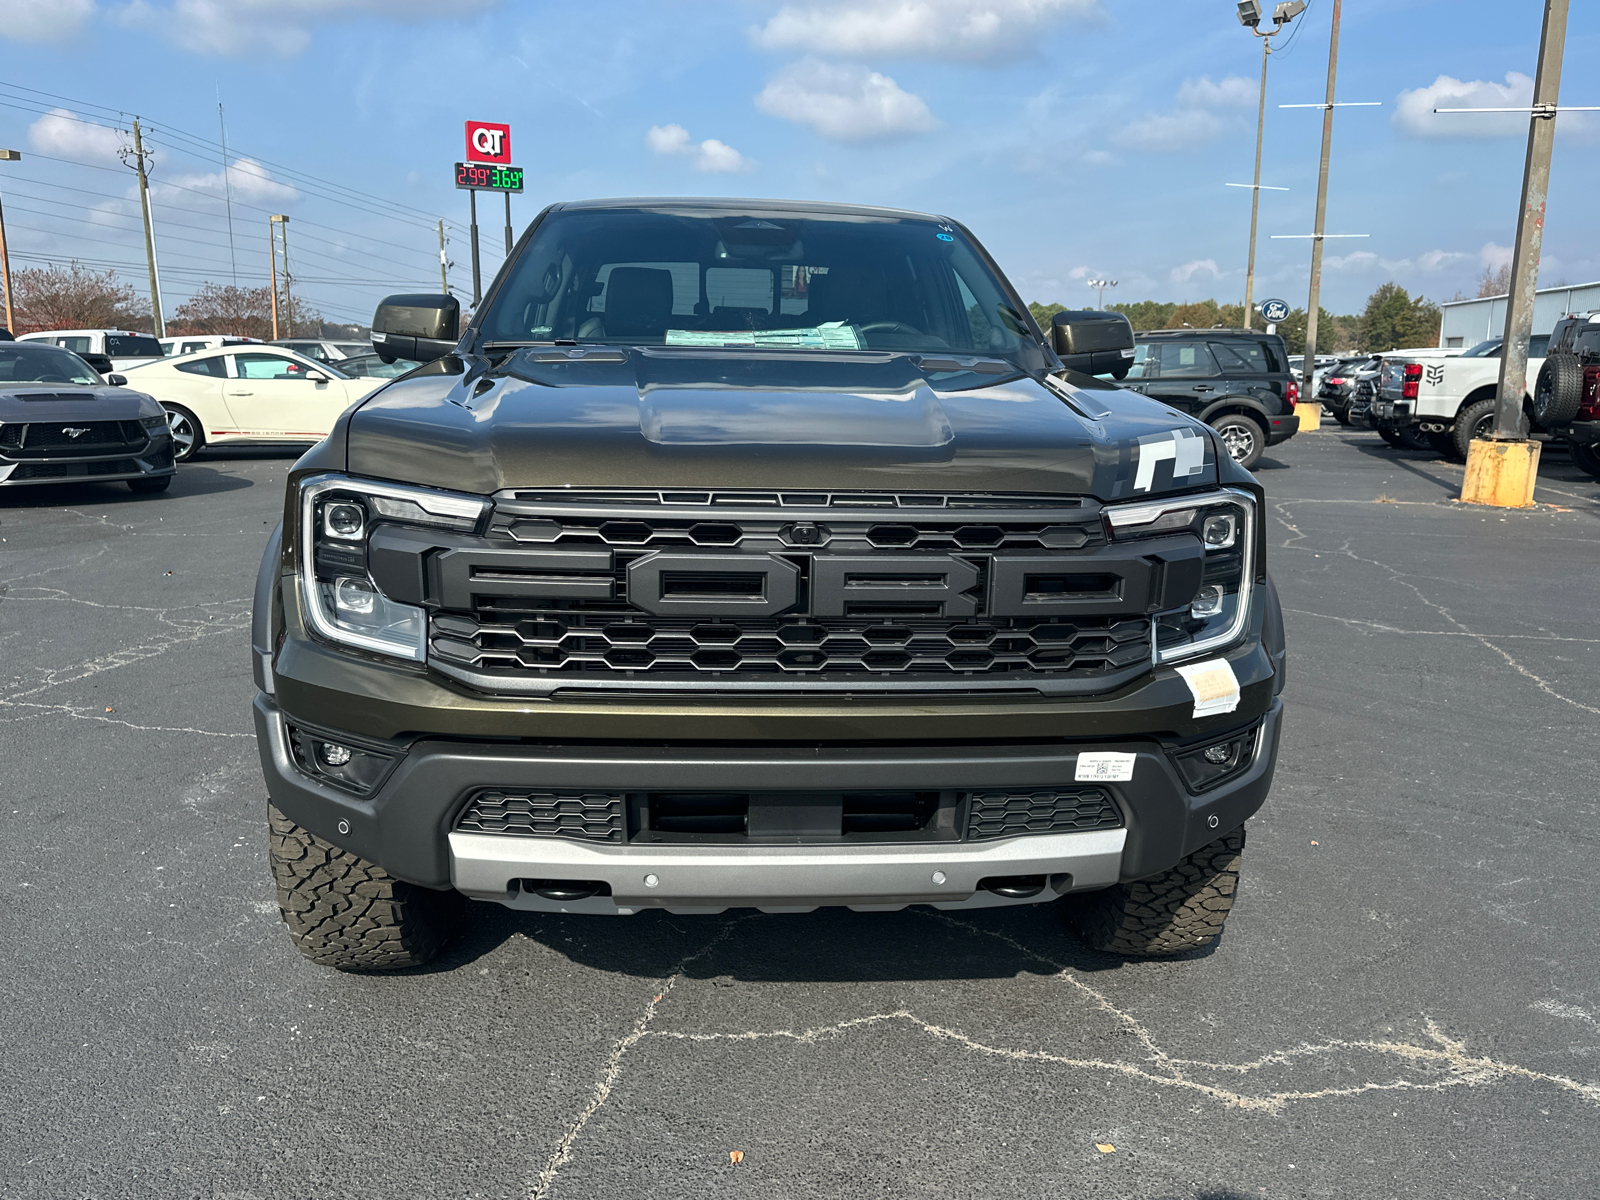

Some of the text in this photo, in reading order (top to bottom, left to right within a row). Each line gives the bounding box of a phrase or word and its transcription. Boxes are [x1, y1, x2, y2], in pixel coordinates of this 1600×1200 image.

[472, 127, 506, 157] QT
[1267, 302, 1286, 318] Ford
[437, 547, 1158, 619] FORD
